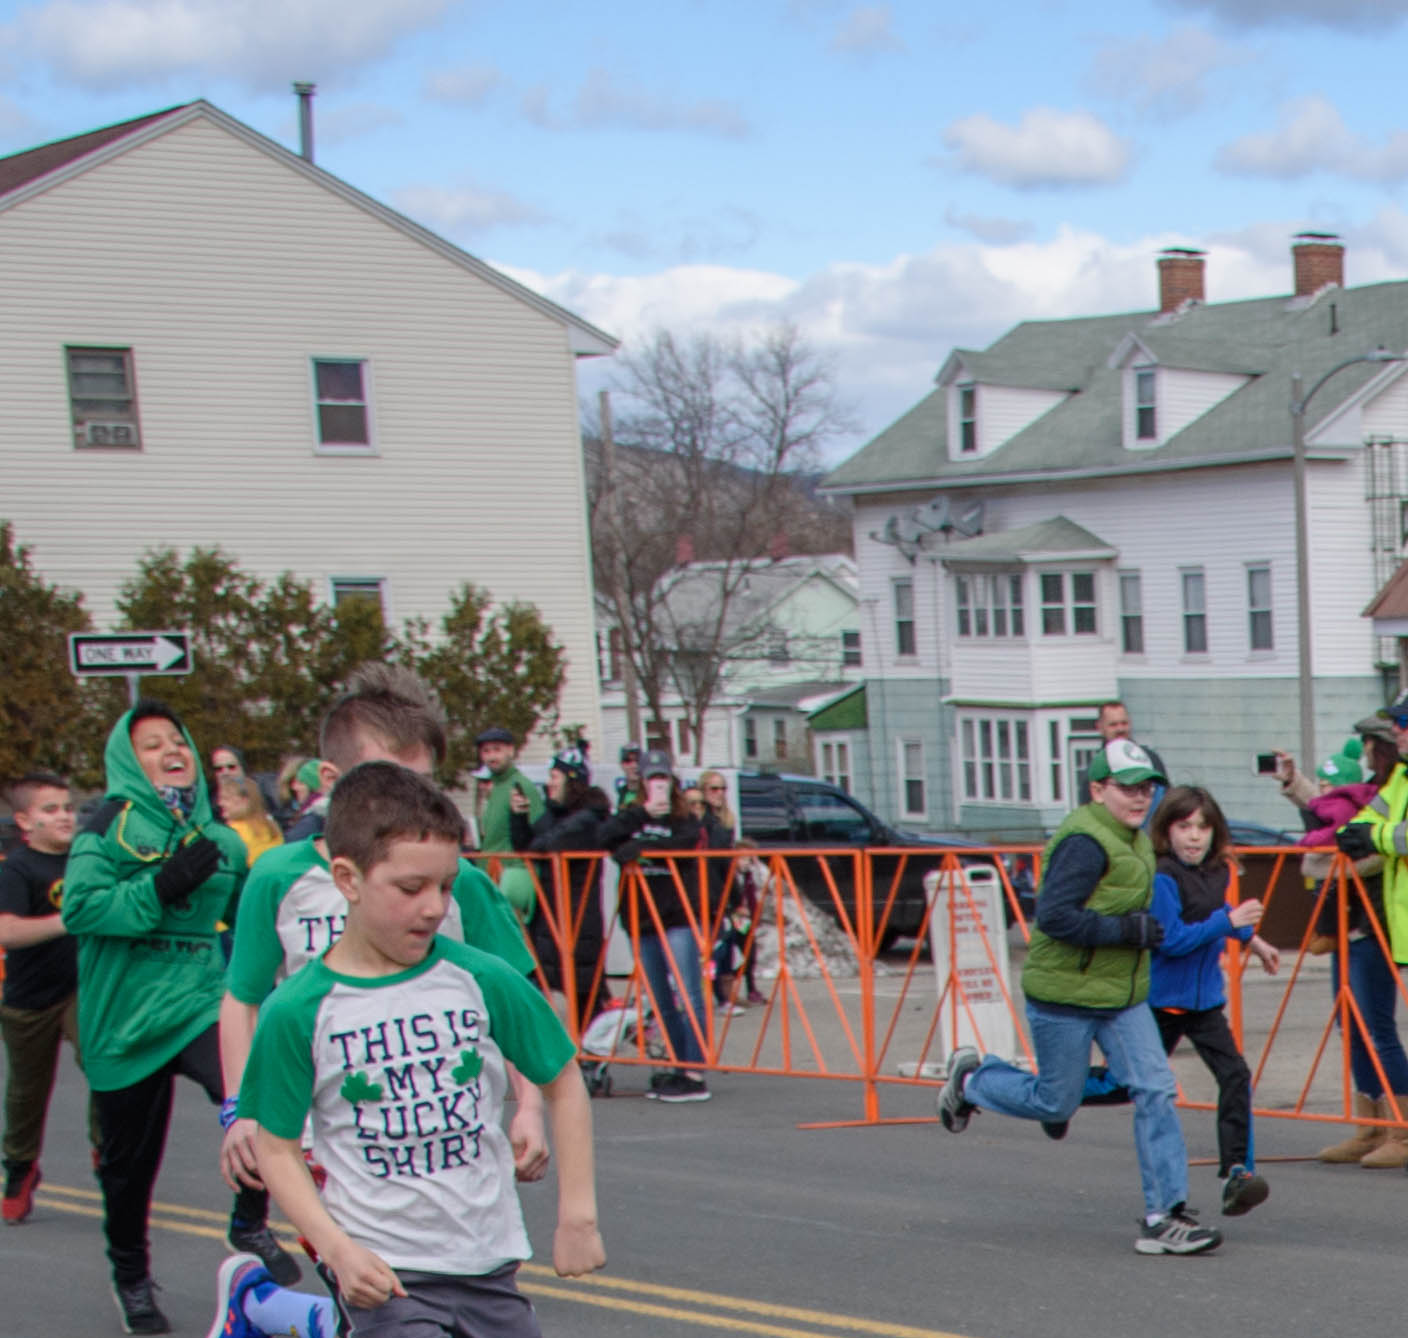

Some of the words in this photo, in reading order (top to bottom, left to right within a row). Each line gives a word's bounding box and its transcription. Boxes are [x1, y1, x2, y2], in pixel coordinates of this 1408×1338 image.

[85, 647, 115, 661] ONE
[122, 646, 153, 660] WAY
[298, 914, 348, 952] TH
[329, 1013, 439, 1070] THIS
[444, 1009, 481, 1047] IS
[383, 1057, 446, 1100] MY
[354, 1080, 482, 1141] LUCKY
[363, 1123, 485, 1178] SHIRT
